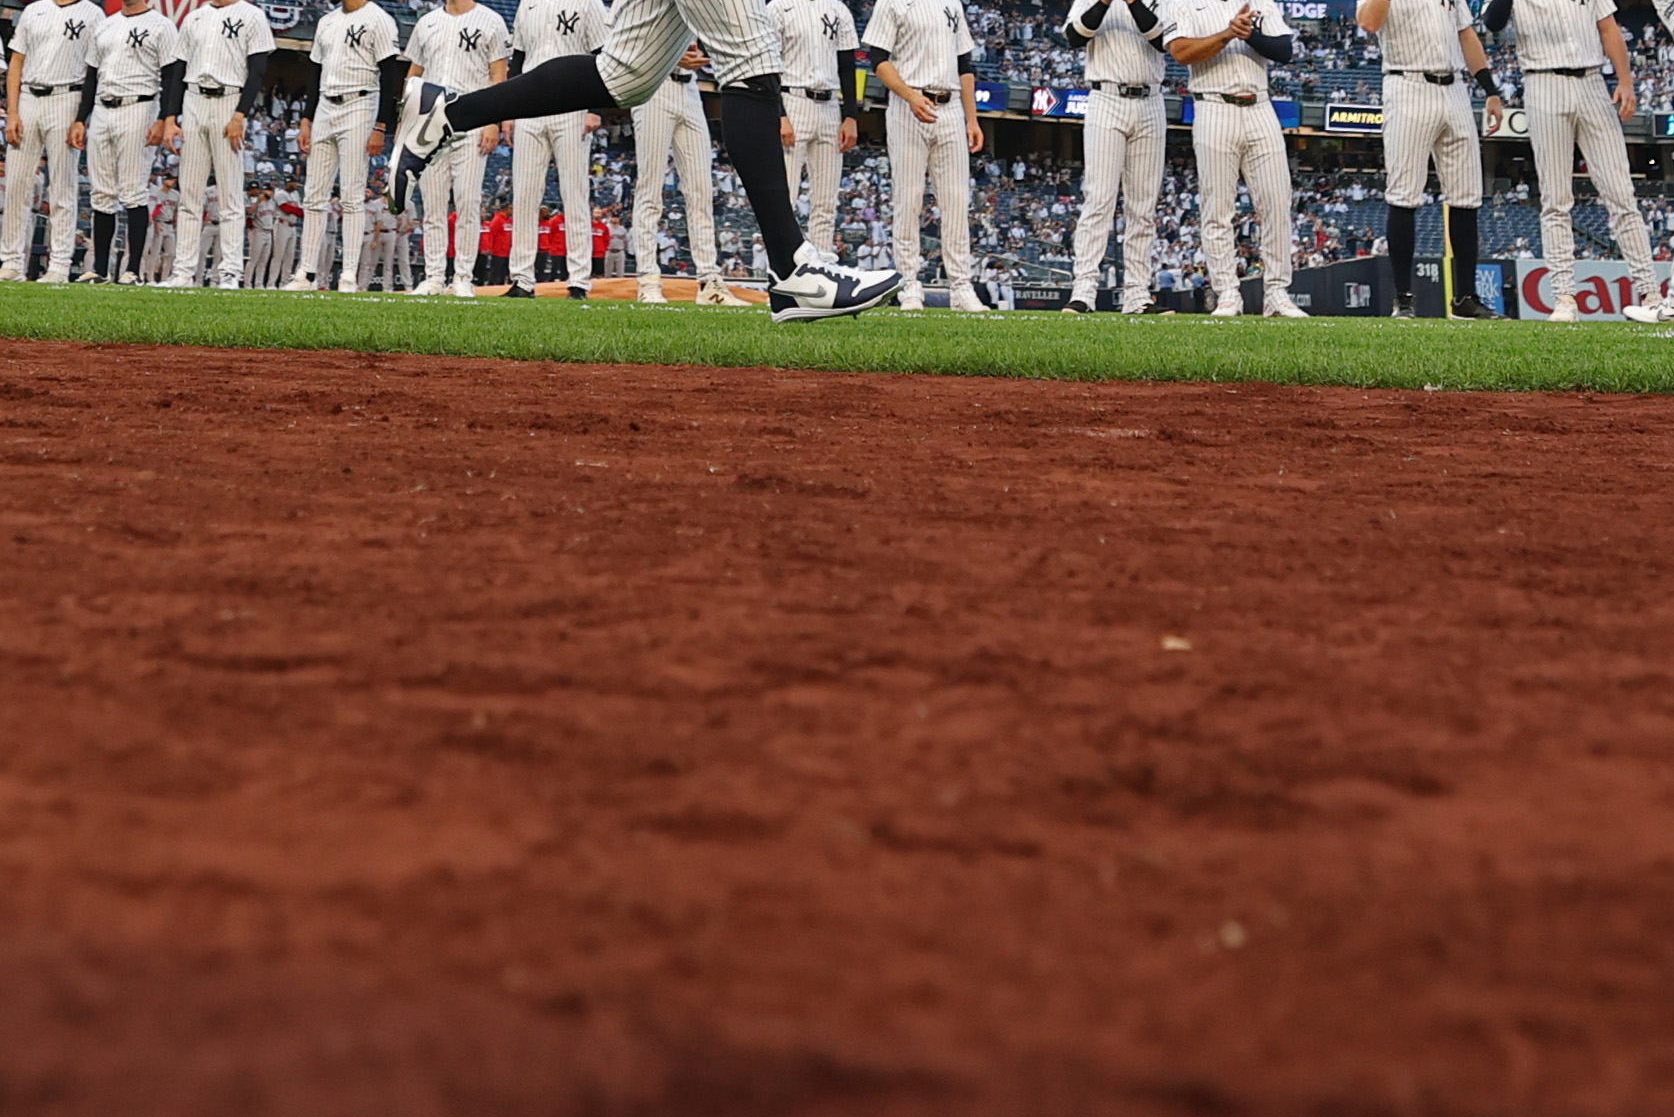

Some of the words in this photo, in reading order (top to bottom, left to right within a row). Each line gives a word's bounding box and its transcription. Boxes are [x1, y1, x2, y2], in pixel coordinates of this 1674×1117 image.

[63, 18, 86, 40] NY
[221, 17, 244, 39] NY
[556, 9, 580, 35] NY
[126, 27, 149, 48] NY
[458, 27, 481, 52] NY
[1065, 101, 1088, 114] JUD
[1330, 111, 1384, 124] ARMITRO
[1416, 263, 1439, 277] 318
[1015, 289, 1060, 300] RAVELLER
